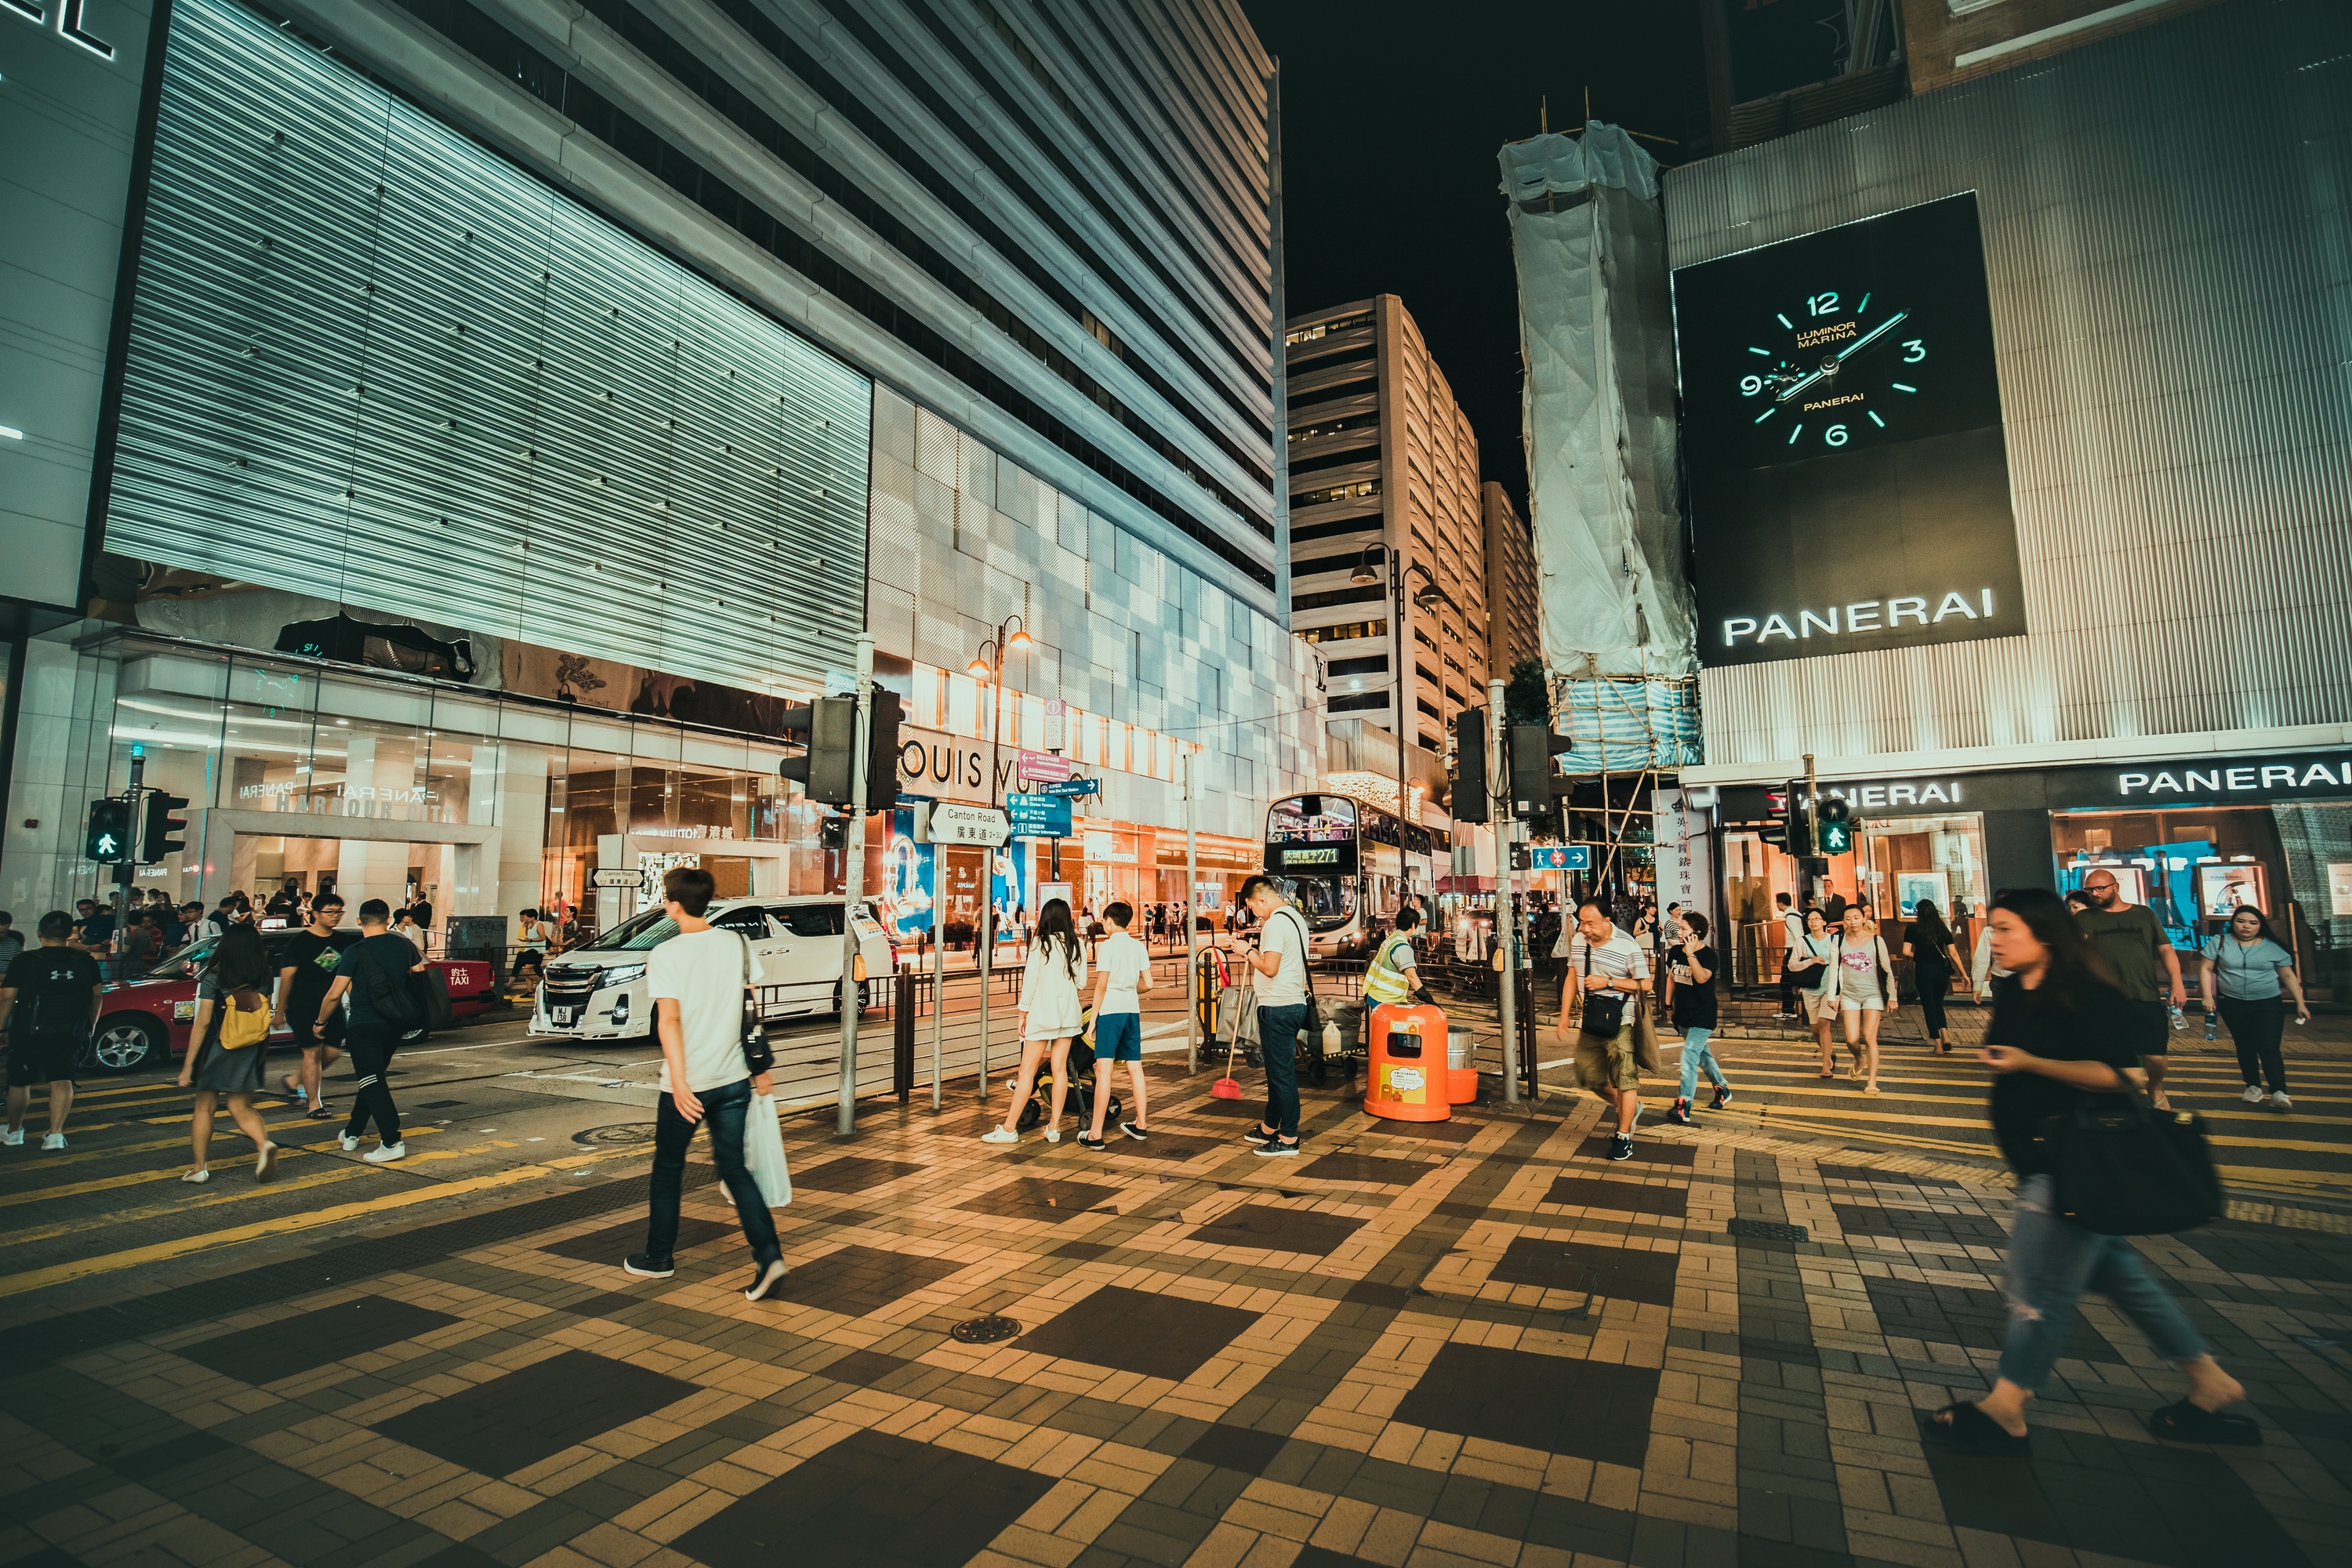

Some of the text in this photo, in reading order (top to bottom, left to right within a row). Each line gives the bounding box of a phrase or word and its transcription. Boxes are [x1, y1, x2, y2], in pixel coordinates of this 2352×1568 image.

[1807, 292, 1840, 317] 12
[1797, 321, 1856, 341] LUMINOR
[1798, 329, 1857, 348] MARINA
[1902, 339, 1926, 363] 3
[1740, 375, 1762, 396] 9
[1803, 393, 1864, 412] PANERAI
[1825, 424, 1848, 446] 6
[1724, 588, 1993, 647] PANERAI
[1048, 717, 1058, 747] 尖沙咀
[902, 740, 1103, 808] OUIS VUON
[2119, 762, 2352, 795] PANERAI
[1797, 782, 1960, 811] NERAI
[276, 793, 455, 823] HARBOUR CITY
[948, 809, 995, 823] Canton Road
[695, 824, 733, 840] 海港城
[957, 826, 986, 840] 廣東道
[1317, 849, 1337, 862] 271
[450, 977, 469, 985] TAXI
[451, 967, 467, 976] 的士
